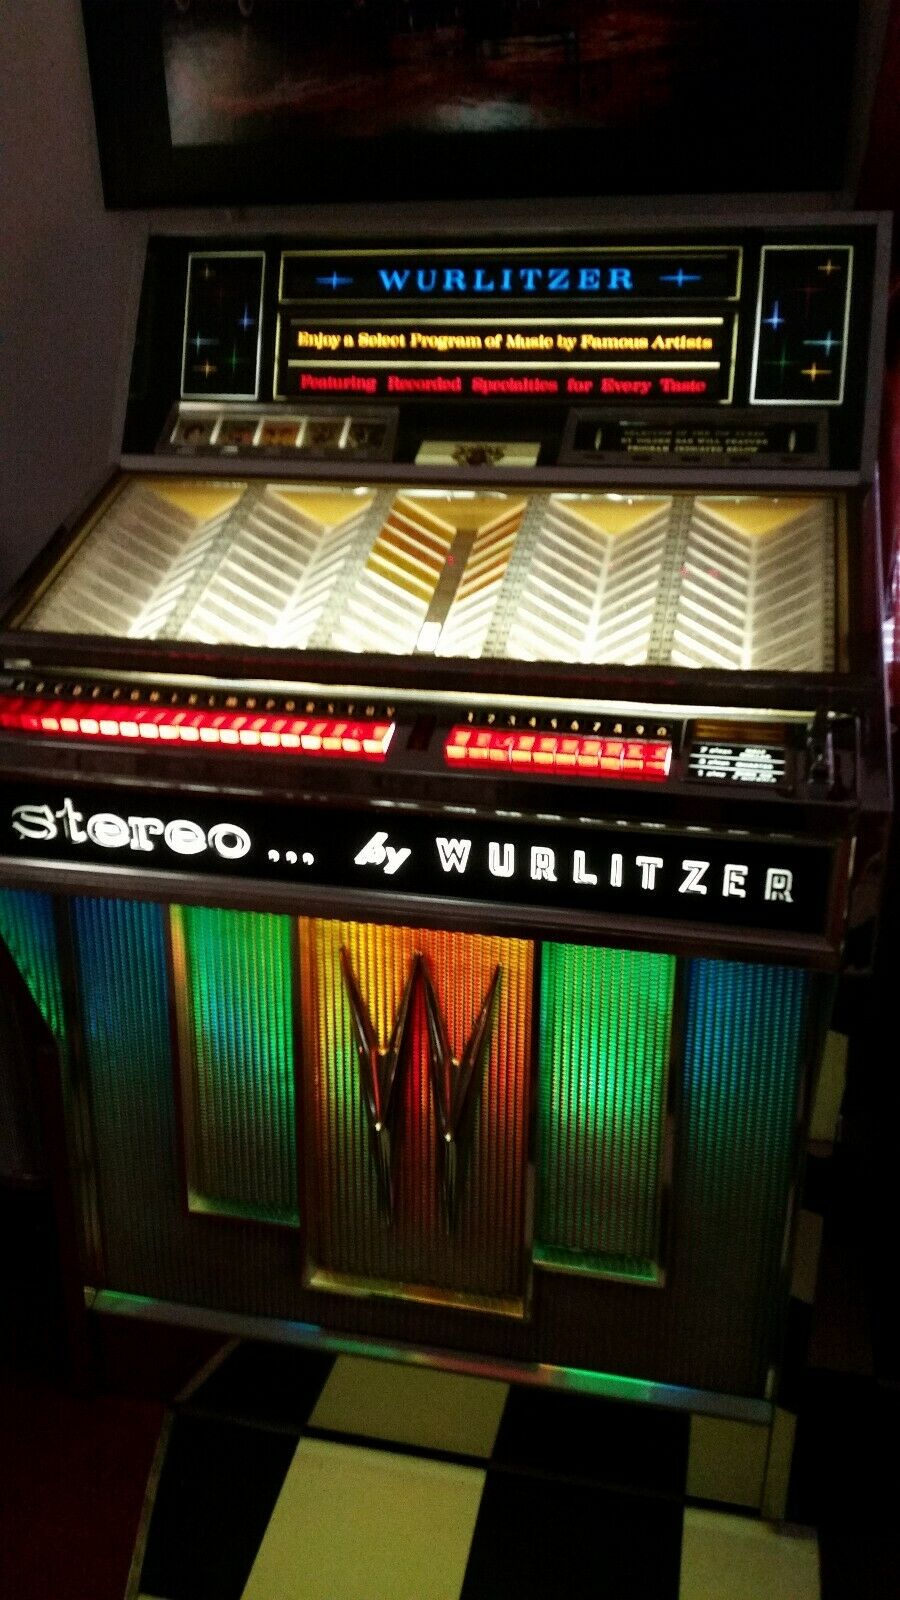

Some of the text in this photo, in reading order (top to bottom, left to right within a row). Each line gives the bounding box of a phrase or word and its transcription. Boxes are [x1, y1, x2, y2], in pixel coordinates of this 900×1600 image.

[379, 267, 633, 291] WURLITZER
[298, 331, 713, 352] Enjoy a Select Program of Music by Famous Artists
[300, 374, 378, 393] Featuring
[387, 376, 462, 392] Recorded
[566, 377, 593, 392] for
[601, 377, 652, 394] Every
[660, 378, 706, 392] Taste
[11, 798, 252, 860] stereo
[354, 831, 411, 875] by
[435, 836, 794, 903] WURLITZER
